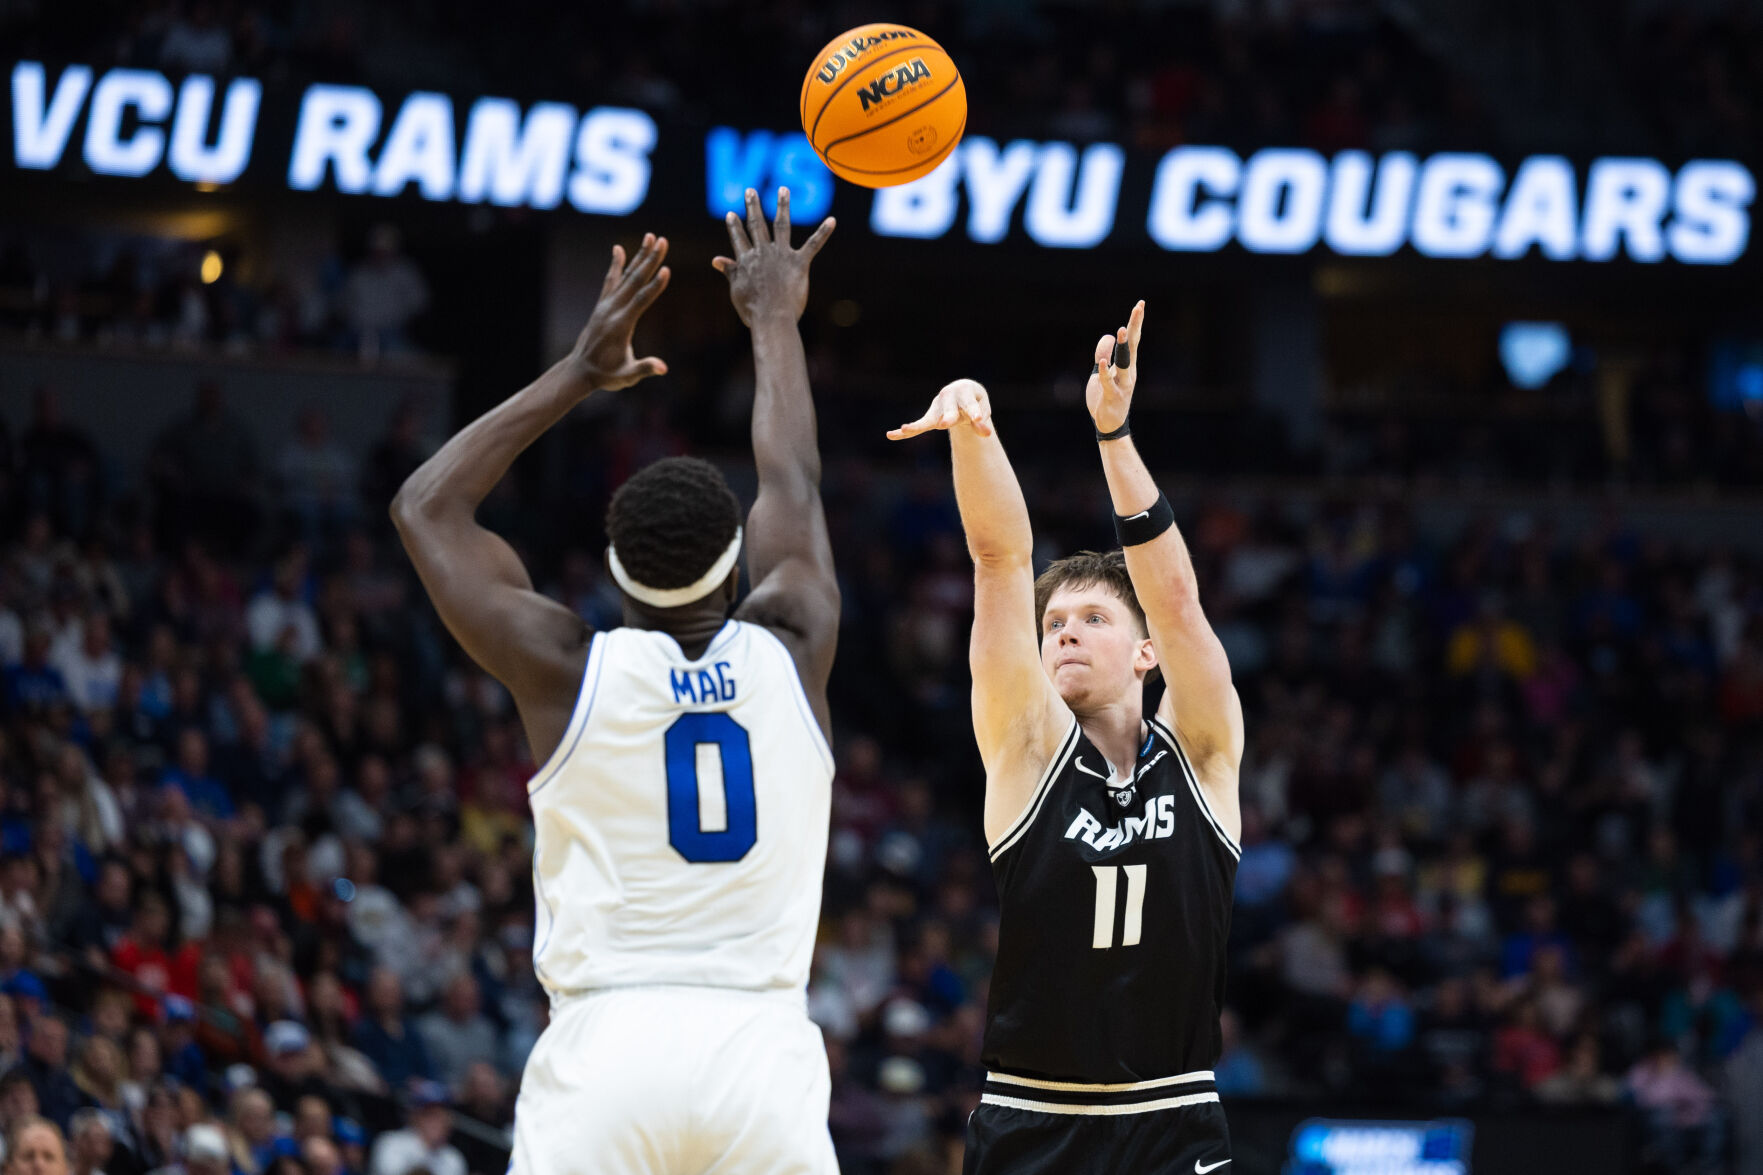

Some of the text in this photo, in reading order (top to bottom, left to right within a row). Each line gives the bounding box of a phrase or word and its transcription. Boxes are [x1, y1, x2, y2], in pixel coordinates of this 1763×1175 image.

[816, 30, 917, 85] Wilson
[856, 57, 932, 112] NCAA
[11, 62, 262, 182] VCU
[288, 84, 657, 215] RAMS
[705, 126, 835, 226] VS
[1147, 145, 1756, 265] COUGARS
[670, 661, 736, 704] MAG
[664, 711, 758, 864] 0
[1064, 794, 1175, 851] RAMS
[1091, 864, 1147, 949] 11
